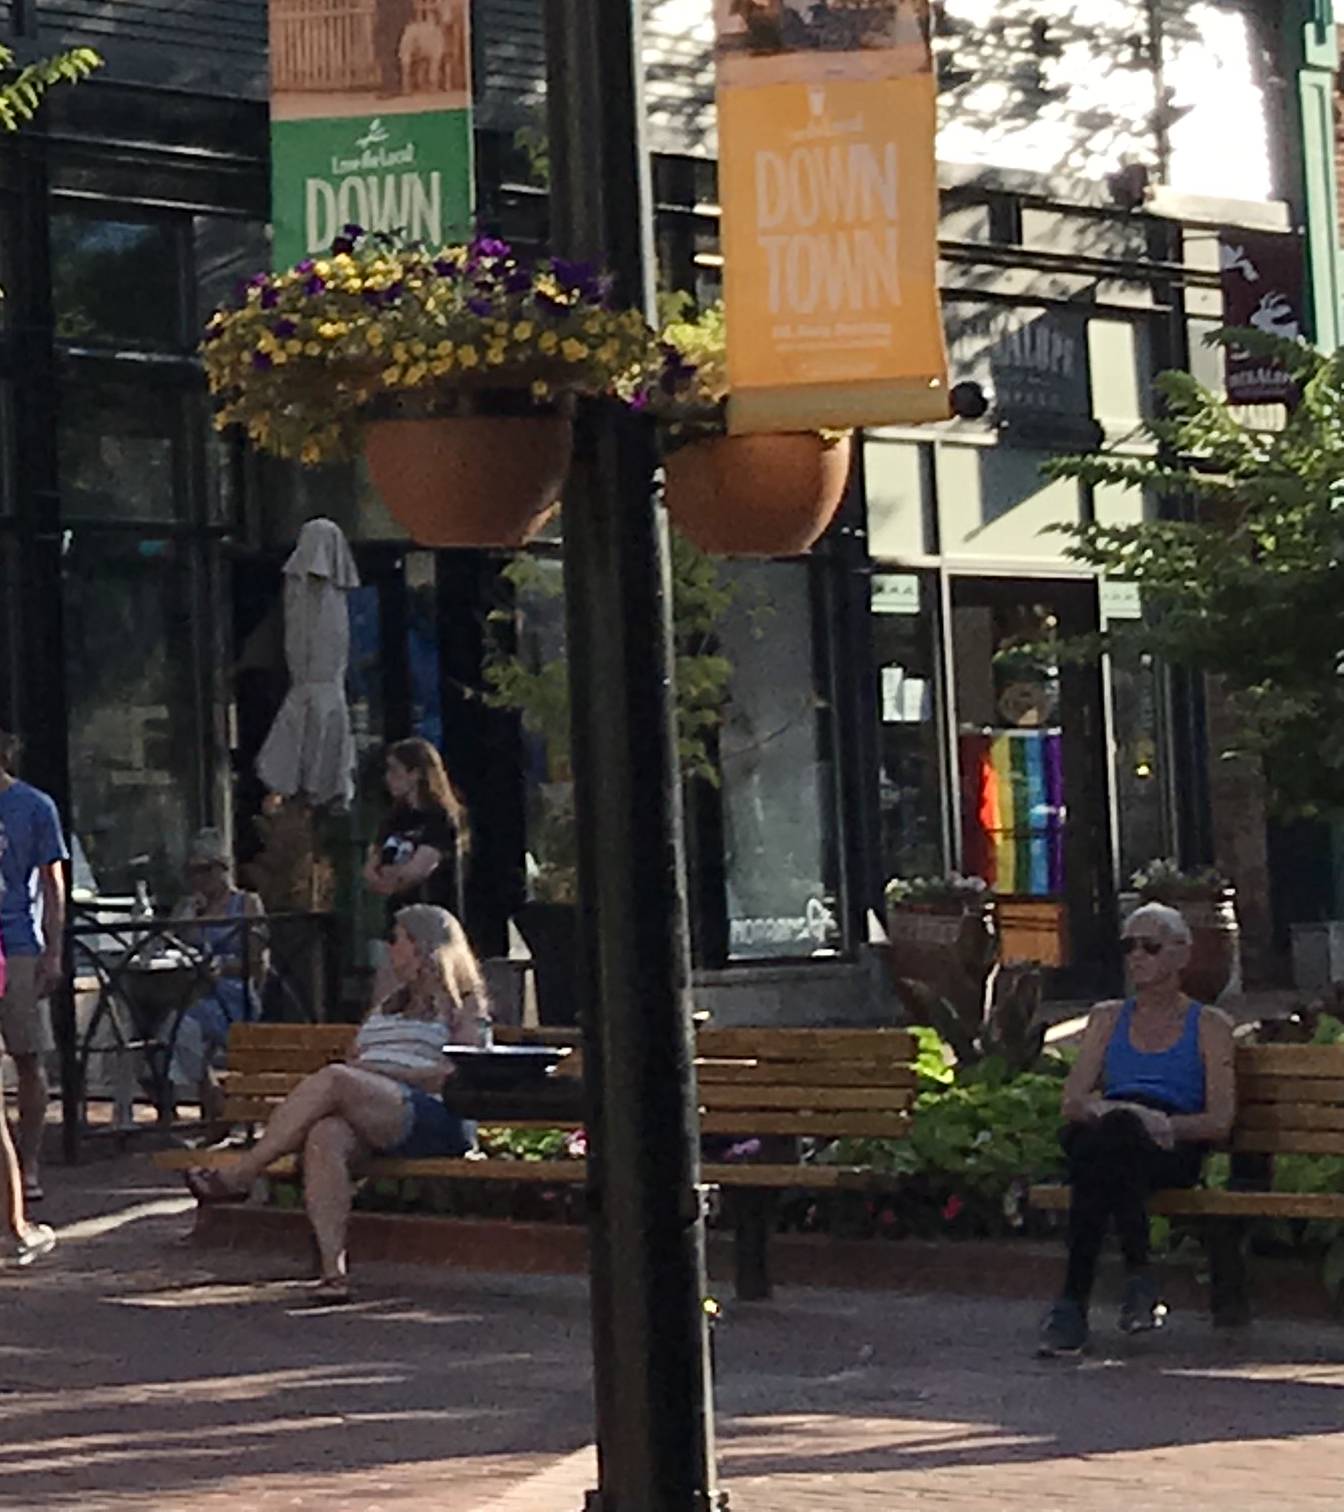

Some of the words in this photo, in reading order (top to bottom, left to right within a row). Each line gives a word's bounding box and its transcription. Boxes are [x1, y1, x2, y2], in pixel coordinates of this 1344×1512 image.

[306, 171, 441, 254] DOWN
[755, 141, 899, 229] DOWN
[758, 226, 903, 314] TOWN
